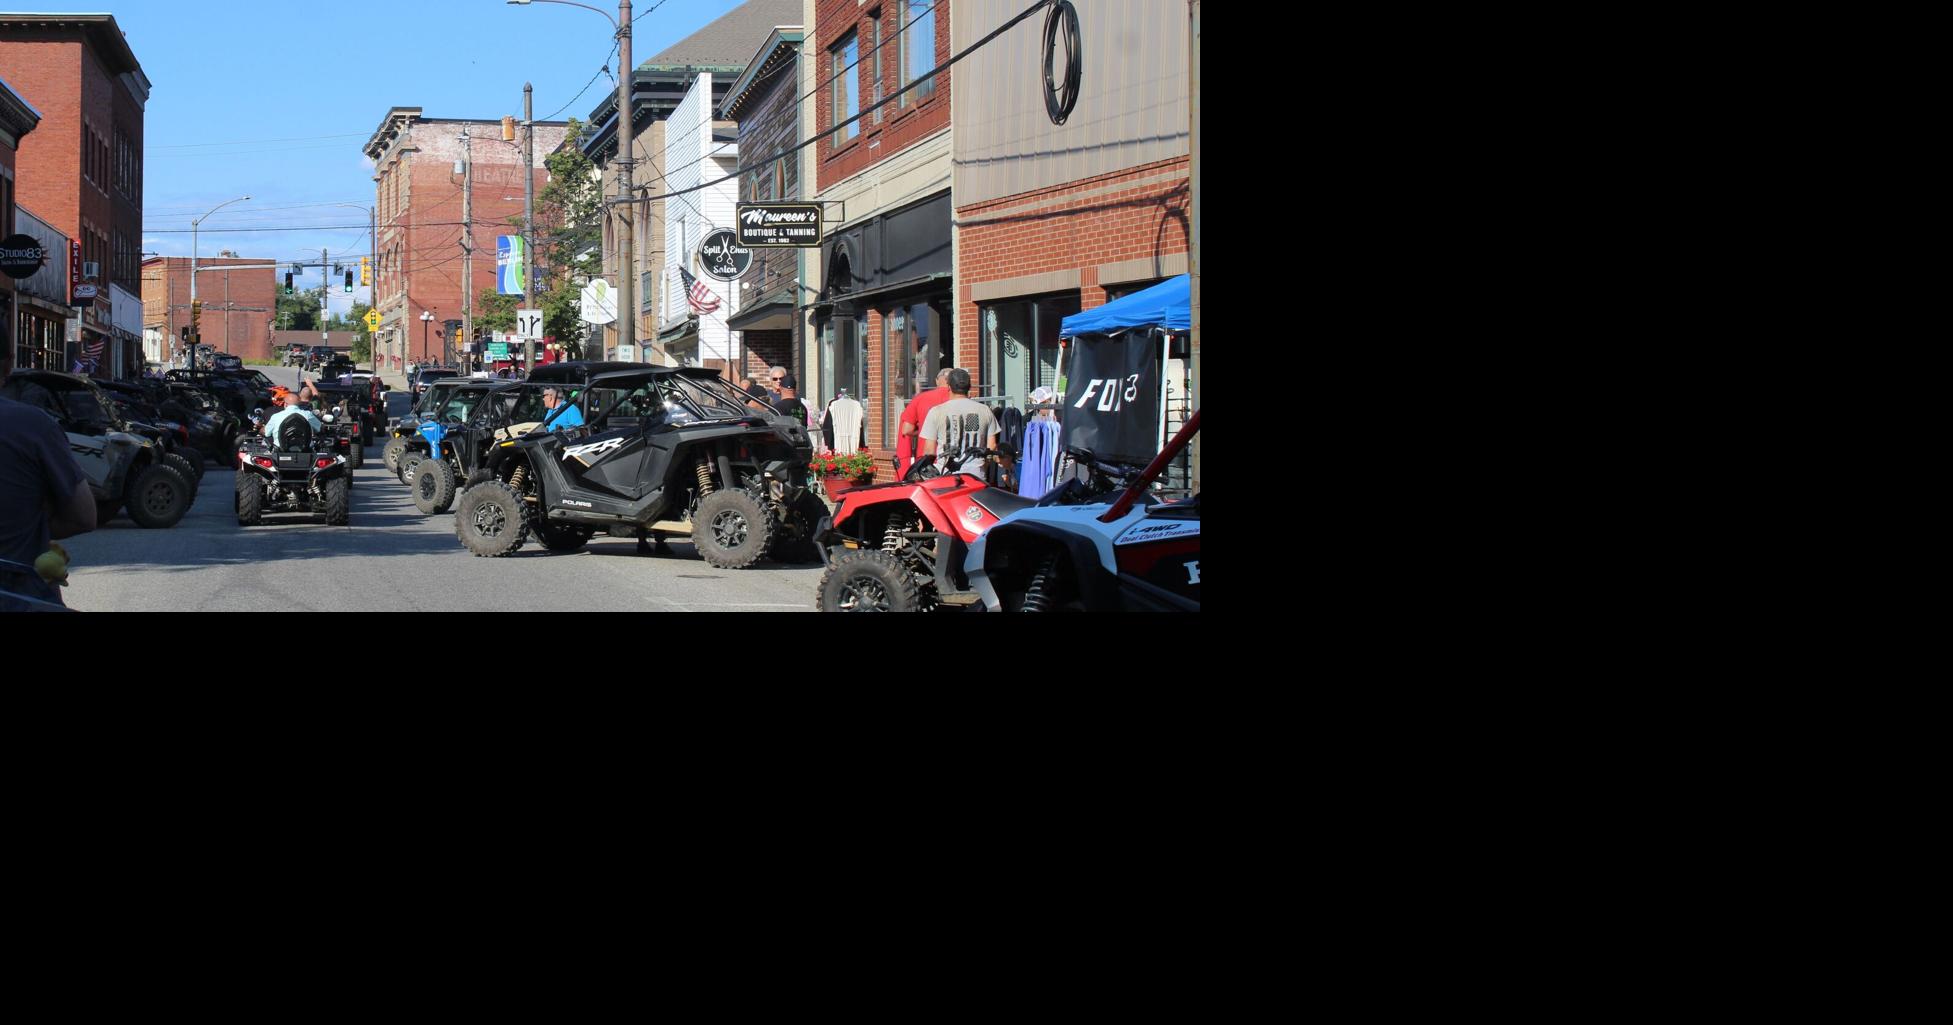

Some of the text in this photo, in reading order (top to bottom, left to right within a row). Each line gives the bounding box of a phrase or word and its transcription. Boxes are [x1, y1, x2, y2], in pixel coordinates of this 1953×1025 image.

[741, 209, 817, 225] Maureen's
[743, 228, 777, 237] BOUTIQUE
[786, 228, 816, 237] TANNING
[703, 245, 721, 256] Split
[713, 264, 738, 274] Salon
[562, 437, 625, 462] RZR
[562, 499, 592, 507] POLARIS
